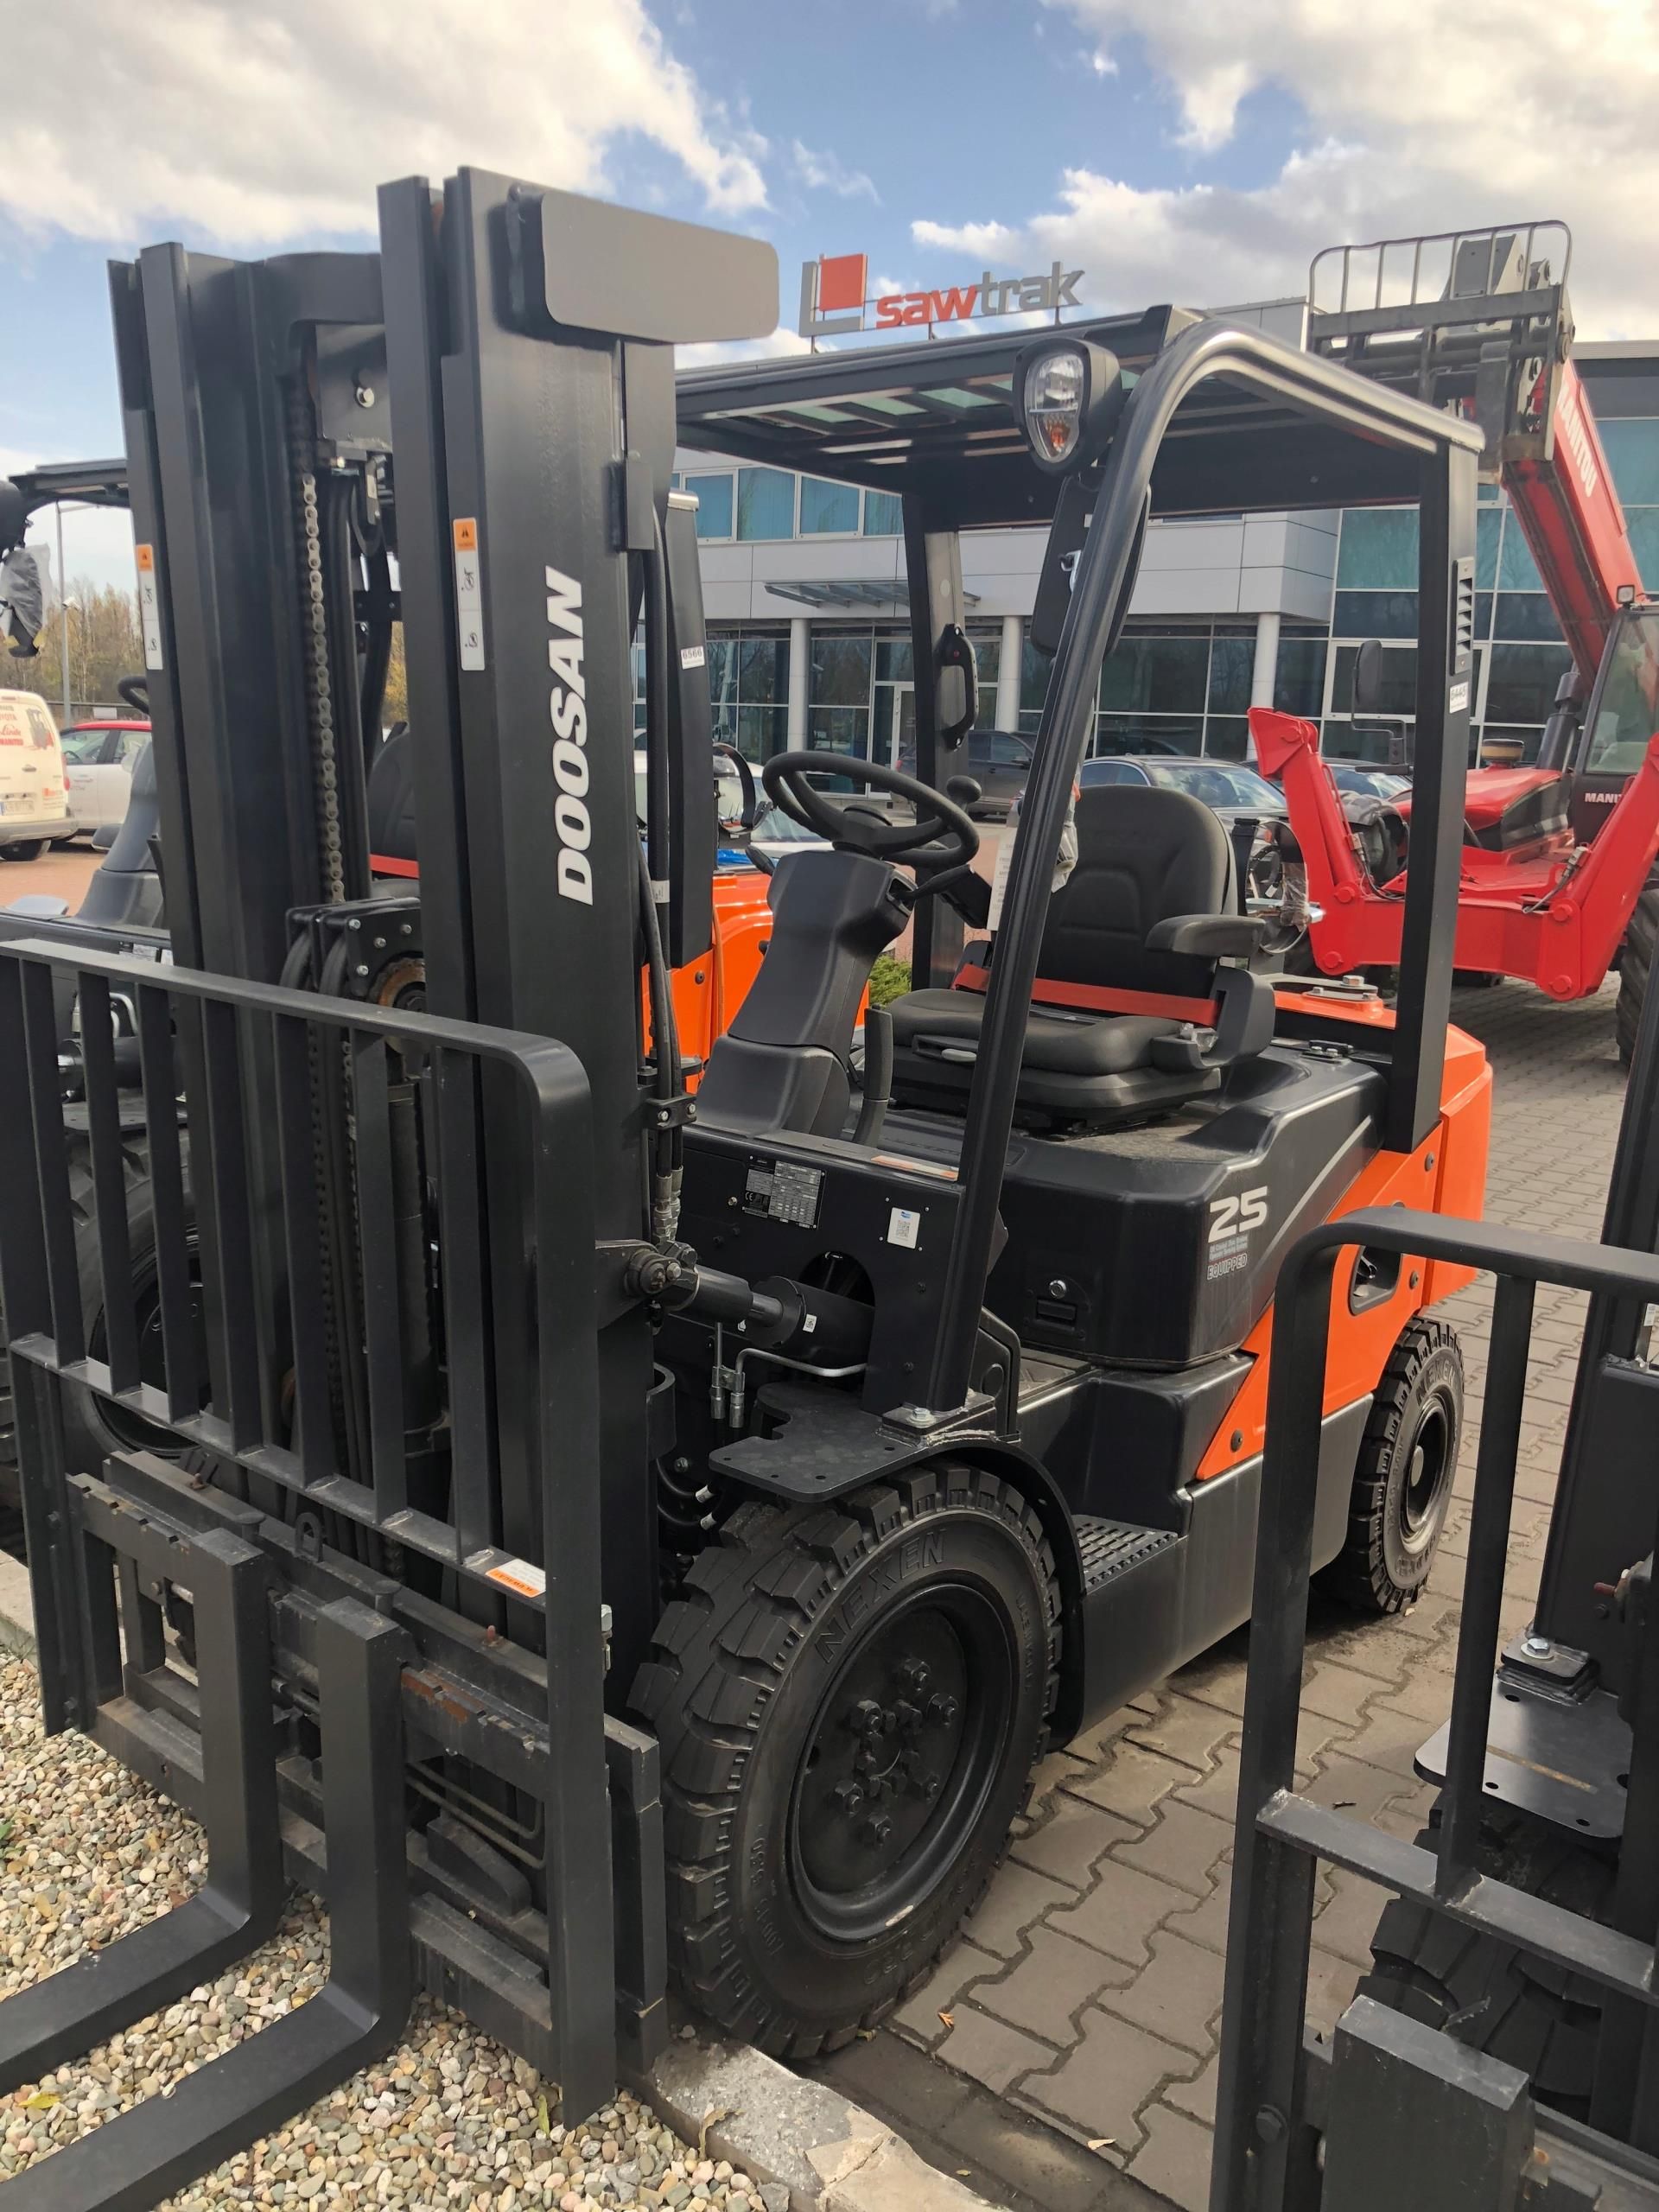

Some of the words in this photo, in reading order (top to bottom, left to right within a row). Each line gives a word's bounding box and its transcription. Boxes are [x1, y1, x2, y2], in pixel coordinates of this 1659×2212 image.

[875, 261, 1085, 329] sawtrak
[545, 565, 594, 906] DOOSAN
[1208, 1185, 1268, 1243] 25
[1206, 1253, 1248, 1281] EQUIPPED
[814, 1528, 948, 1664] NEXEN
